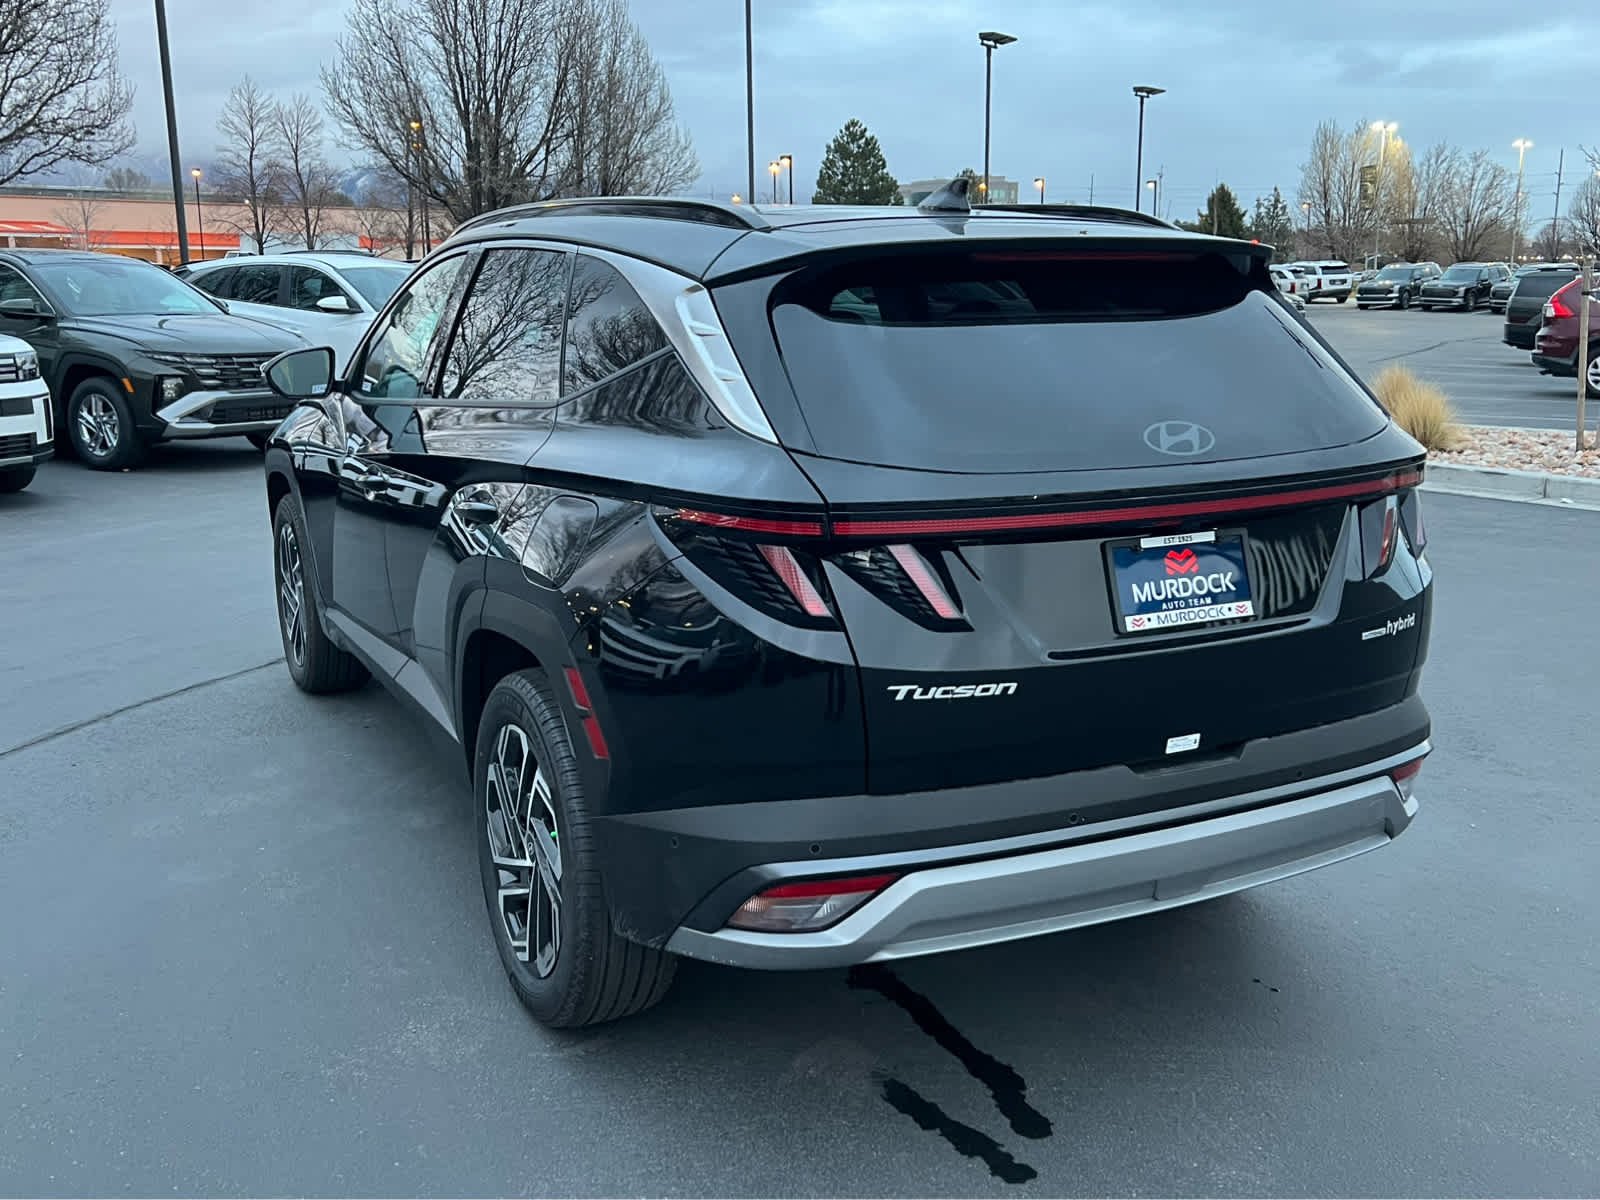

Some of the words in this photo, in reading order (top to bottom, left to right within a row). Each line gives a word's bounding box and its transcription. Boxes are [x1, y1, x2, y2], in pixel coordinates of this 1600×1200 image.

[1131, 571, 1237, 604] MURDOCK
[1161, 600, 1186, 611] AUTO
[1189, 597, 1213, 607] TEAM
[1156, 606, 1226, 626] MURDOCK
[1386, 612, 1416, 636] hybrid
[887, 682, 1018, 701] Tucson
